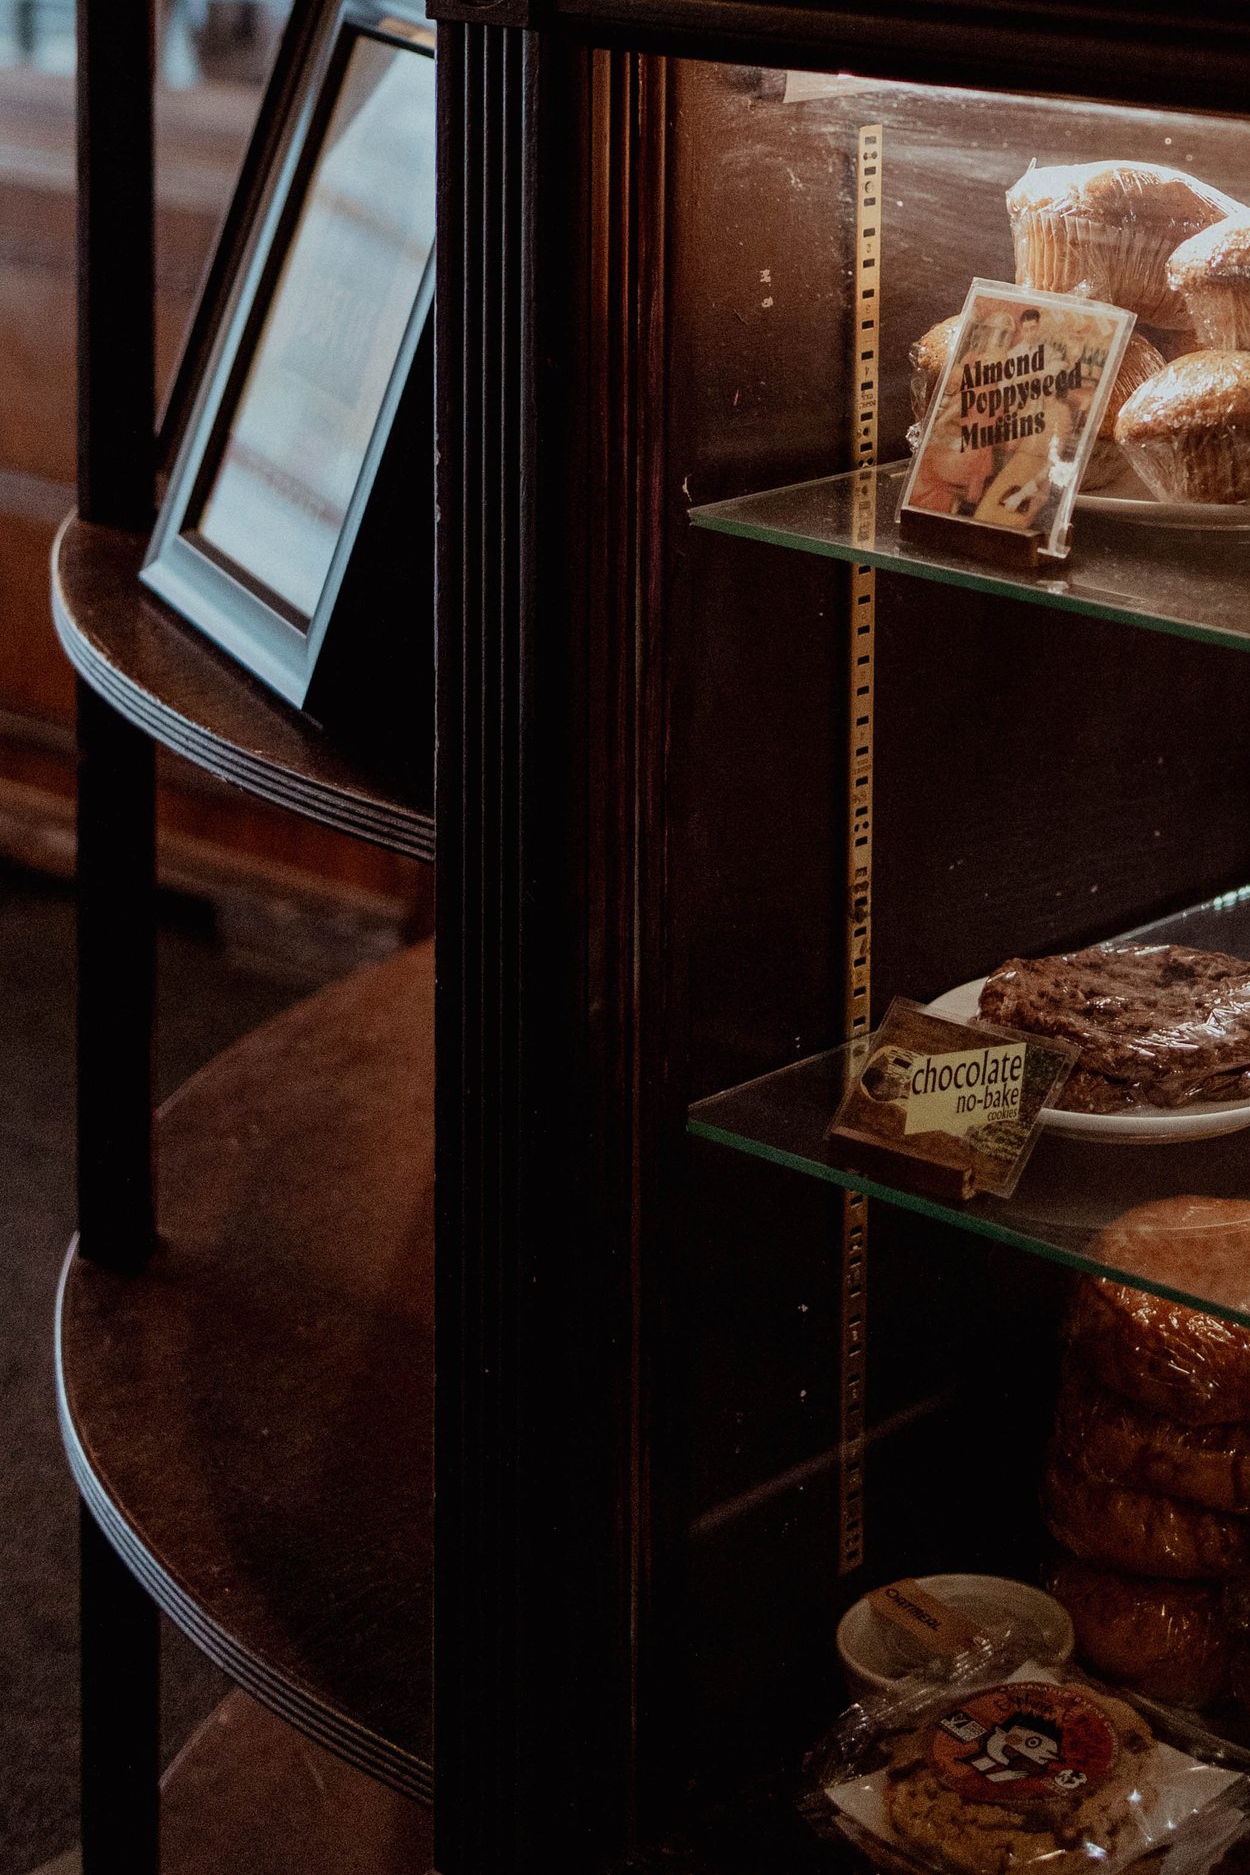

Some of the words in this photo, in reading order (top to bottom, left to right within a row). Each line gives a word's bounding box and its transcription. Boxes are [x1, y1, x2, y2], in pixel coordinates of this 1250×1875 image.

[959, 344, 1045, 391] Almond
[960, 362, 1083, 418] Poppyseed
[960, 411, 1046, 453] Muffins
[910, 1050, 1023, 1096] chocolate
[955, 1083, 1020, 1115] no-bake
[986, 1106, 1018, 1122] cookies
